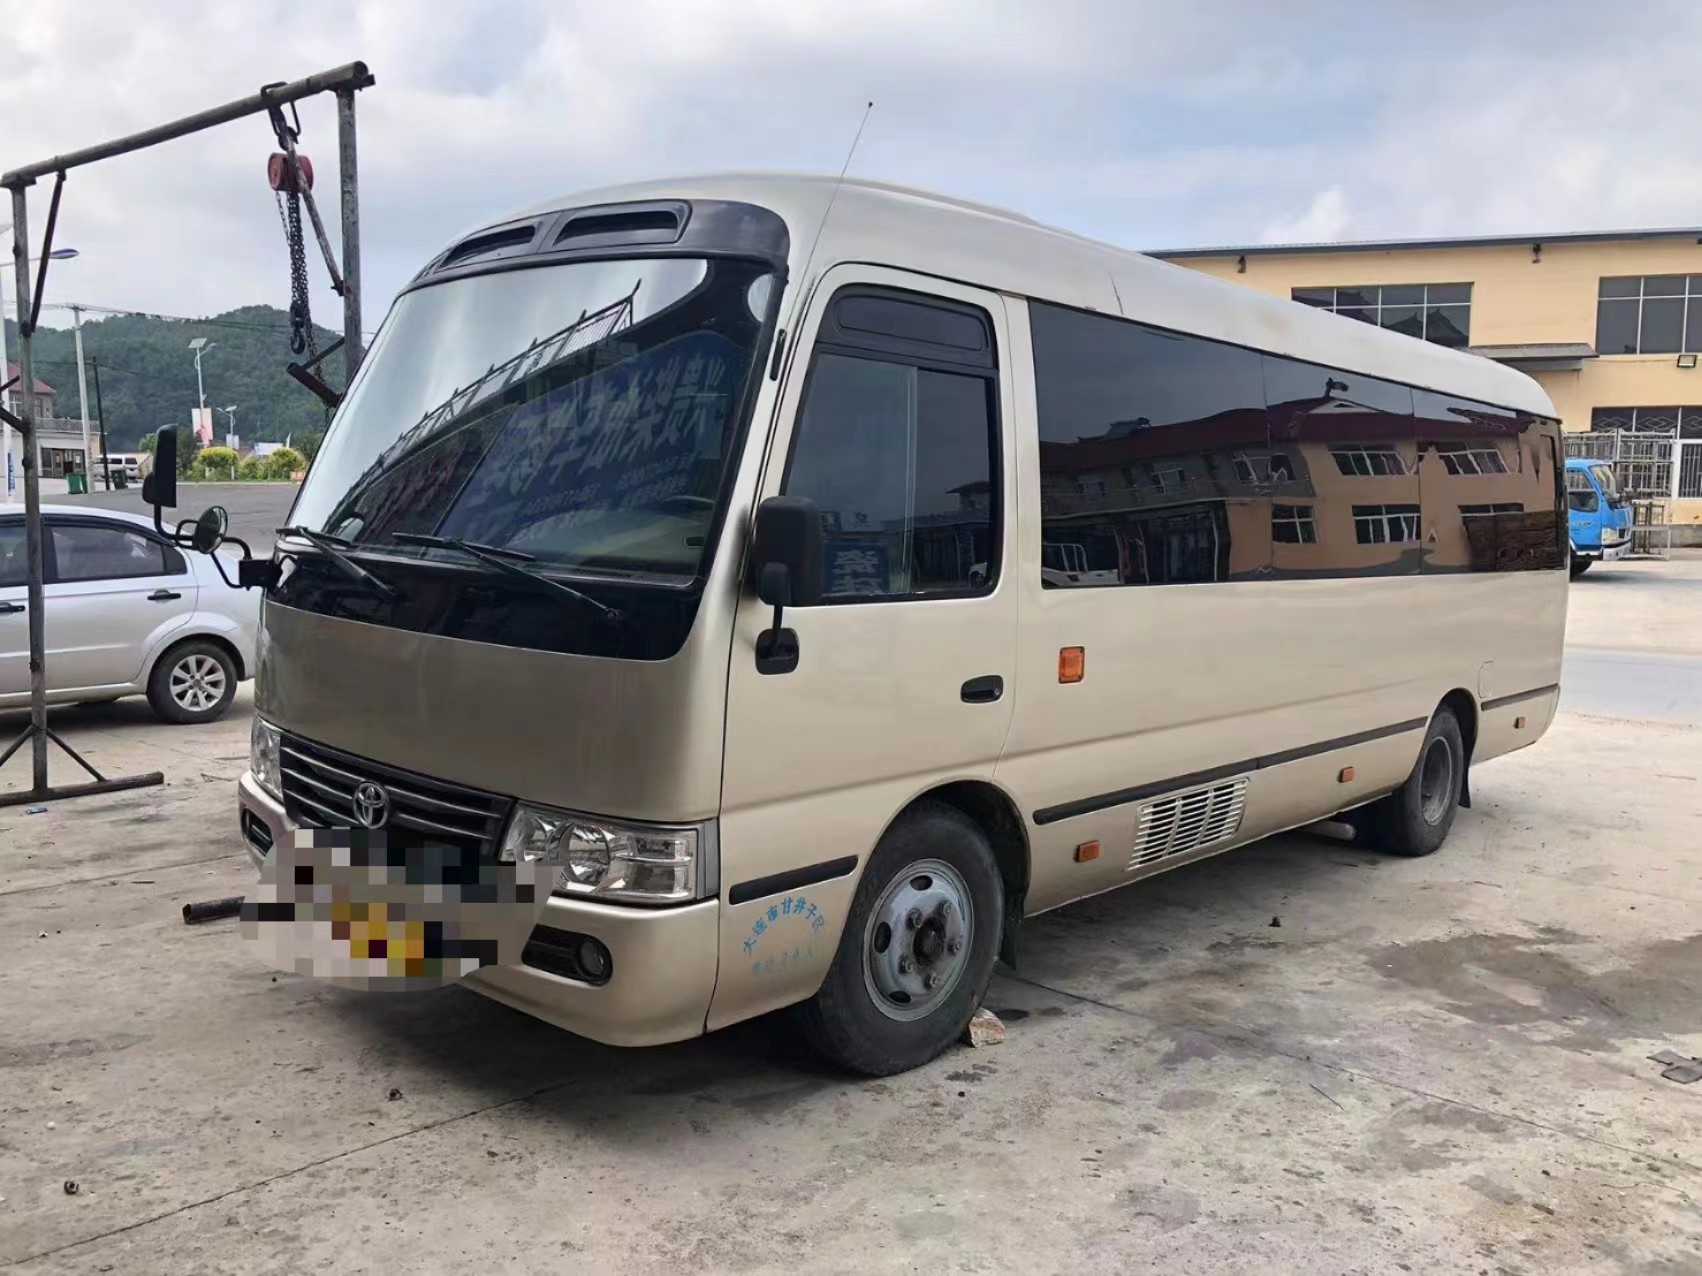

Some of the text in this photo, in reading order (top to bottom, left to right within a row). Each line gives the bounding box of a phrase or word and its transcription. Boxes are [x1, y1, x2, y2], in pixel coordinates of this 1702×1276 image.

[743, 896, 825, 954] 大连市甘井子区
